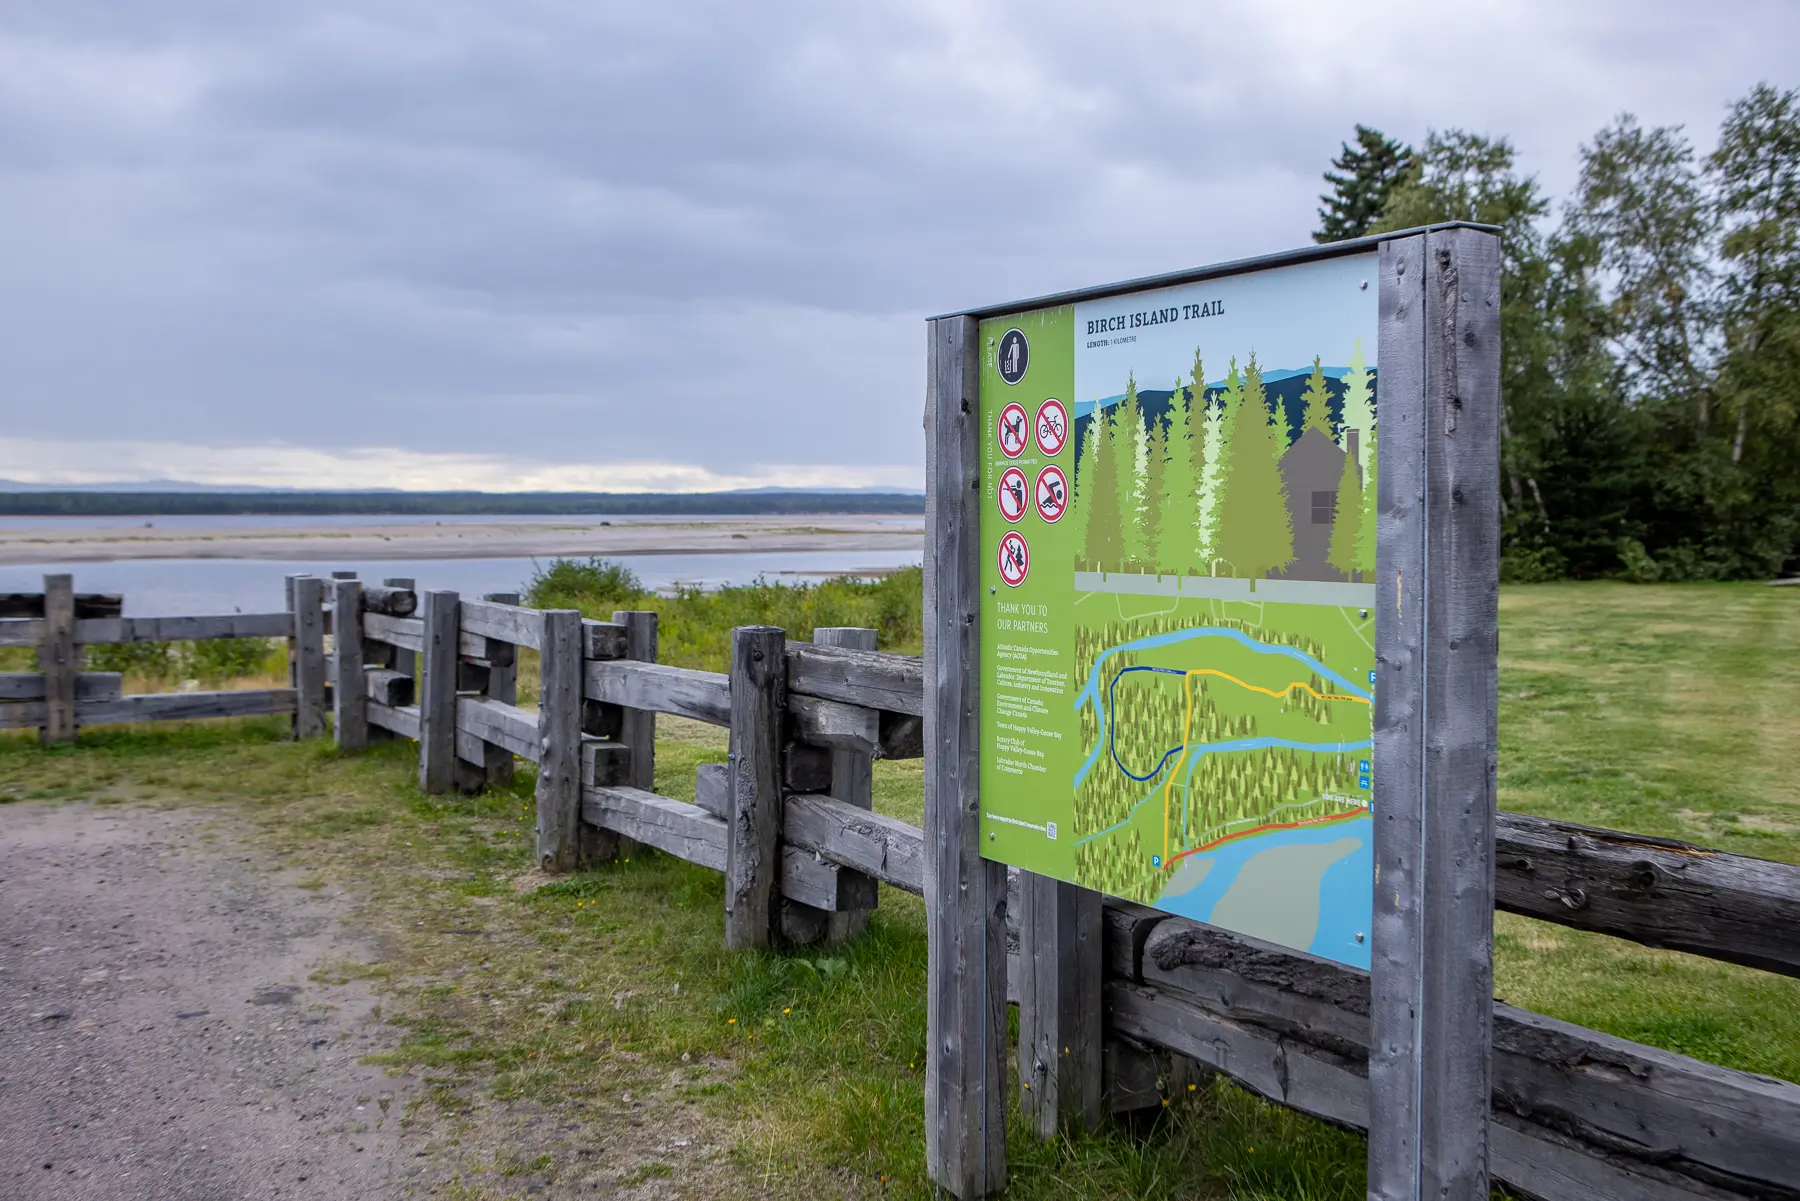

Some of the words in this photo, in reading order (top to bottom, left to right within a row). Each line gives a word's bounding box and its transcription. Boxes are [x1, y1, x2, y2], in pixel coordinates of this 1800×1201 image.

[1087, 315, 1126, 334] BIRCH
[1130, 308, 1178, 328] ISLAND
[1182, 300, 1224, 320] TRAIL
[1086, 340, 1110, 348] LENGTH:
[1114, 336, 1136, 344] KILOMETRE
[997, 602, 1019, 614] THANK
[1021, 604, 1036, 615] YOU
[1038, 605, 1048, 616] TO
[997, 619, 1011, 630] OUR
[1013, 620, 1048, 634] PARTNERS
[997, 651, 1011, 659] Agency
[1029, 647, 1058, 656] Opportunities
[997, 665, 1021, 674] Government
[1027, 668, 1058, 678] Newfoundland
[1016, 674, 1041, 683] Department
[1014, 681, 1031, 691] Industry
[1040, 685, 1063, 694] Innovation
[997, 693, 1021, 702] Government
[997, 700, 1023, 709] Environment
[1032, 706, 1048, 714] Climate
[997, 708, 1012, 716] Change
[1012, 710, 1027, 718] Canada
[1013, 724, 1026, 733] Happy
[1027, 727, 1053, 737] Valley-Goose
[1054, 732, 1062, 740] Bay
[997, 736, 1010, 744] Rotary
[997, 743, 1010, 752] Happy
[1010, 745, 1036, 756] Valley-Goose
[997, 756, 1014, 765] Labrador
[1015, 760, 1027, 768] North
[1028, 763, 1046, 772] Chamber
[1002, 765, 1023, 775] Commerce
